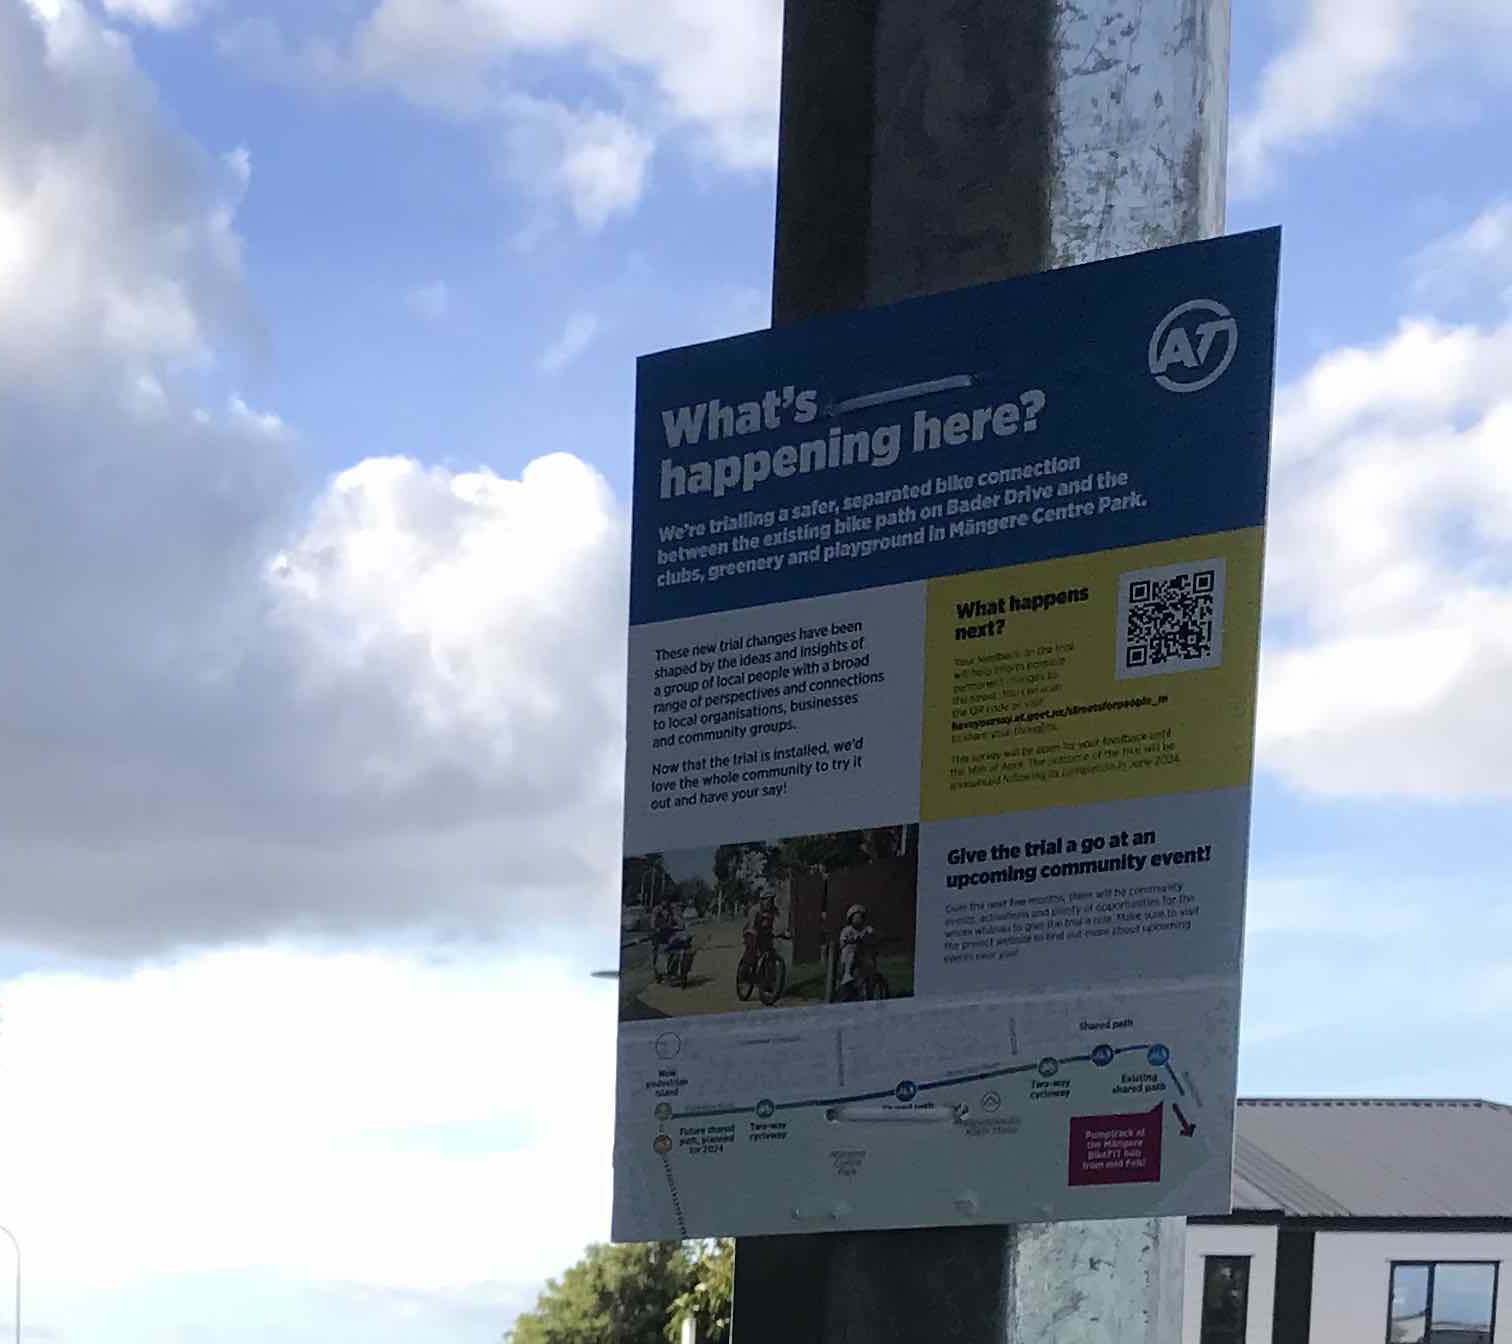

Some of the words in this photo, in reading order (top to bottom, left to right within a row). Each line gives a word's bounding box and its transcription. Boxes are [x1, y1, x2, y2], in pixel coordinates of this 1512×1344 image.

[1149, 316, 1237, 374] AT
[661, 385, 818, 448] What's
[660, 424, 902, 499] happening
[911, 389, 1046, 453] here?
[657, 544, 729, 565] between
[732, 535, 760, 552] the
[763, 524, 831, 546] existing
[834, 514, 872, 535] bike
[875, 505, 917, 531] path
[920, 504, 943, 520] on
[947, 494, 1000, 516] Bader
[1004, 483, 1053, 505] Drive
[1057, 476, 1093, 497] and
[1097, 472, 1128, 489] the
[659, 524, 706, 542] We're
[710, 510, 775, 534] trialling
[778, 508, 788, 522] a
[791, 499, 840, 520] safer,
[843, 477, 932, 511] separated
[935, 475, 973, 494] bike
[978, 455, 1081, 486] connection
[657, 567, 705, 587] clubs,
[708, 554, 784, 580] greenery
[788, 544, 820, 566] and
[823, 525, 925, 562] playground
[928, 524, 945, 542] in
[1032, 502, 1095, 524] Centre
[1099, 491, 1147, 514] Park.
[957, 598, 1005, 619] What
[1009, 588, 1088, 611] happens
[655, 648, 689, 661] These
[692, 645, 715, 657] new
[720, 637, 743, 652] trial
[746, 630, 796, 648] changes
[799, 624, 828, 641] have
[831, 622, 862, 635] been
[955, 619, 1005, 640] next?
[654, 661, 697, 680] shaped
[700, 658, 715, 674] by
[718, 653, 737, 669] the
[740, 651, 771, 665] ideas
[775, 645, 797, 661] and
[800, 638, 848, 657] insights
[851, 637, 865, 650] of
[654, 687, 661, 696] a
[664, 681, 699, 696] group
[702, 676, 716, 689] of
[717, 672, 745, 688] local
[748, 666, 789, 683] people
[792, 662, 819, 677] with
[822, 662, 829, 672] a
[832, 654, 870, 671] broad
[653, 699, 687, 714] range
[690, 696, 702, 708] of
[705, 686, 781, 706] perspectives
[783, 681, 806, 696] and
[809, 671, 885, 692] connections
[653, 719, 666, 731] to
[668, 713, 697, 729] local
[700, 702, 787, 725] organisations,
[790, 694, 858, 712] businesses
[652, 734, 675, 748] and
[678, 722, 746, 745] community
[749, 719, 796, 736] groups.
[651, 778, 676, 792] love
[679, 775, 698, 789] the
[702, 771, 738, 786] whole
[742, 759, 812, 781] community
[816, 760, 828, 772] to
[832, 757, 850, 772] try
[853, 755, 862, 768] it
[652, 762, 679, 775] Now
[682, 757, 706, 771] that
[710, 754, 730, 768] the
[733, 750, 758, 765] trial
[761, 749, 770, 762] is
[774, 742, 829, 761] installed,
[834, 737, 864, 753] we'd
[650, 797, 671, 810] out
[675, 791, 697, 807] and
[700, 789, 729, 805] have
[732, 786, 759, 802] your
[762, 782, 787, 797] say!
[946, 866, 1036, 889] upcoming
[1040, 852, 1147, 878] community
[1151, 845, 1211, 867] event!
[947, 848, 987, 865] Give
[991, 843, 1020, 861] the
[1025, 837, 1062, 857] trial
[1067, 839, 1077, 852] a
[1081, 836, 1105, 854] go
[1109, 831, 1129, 847] at
[1133, 830, 1155, 845] an
